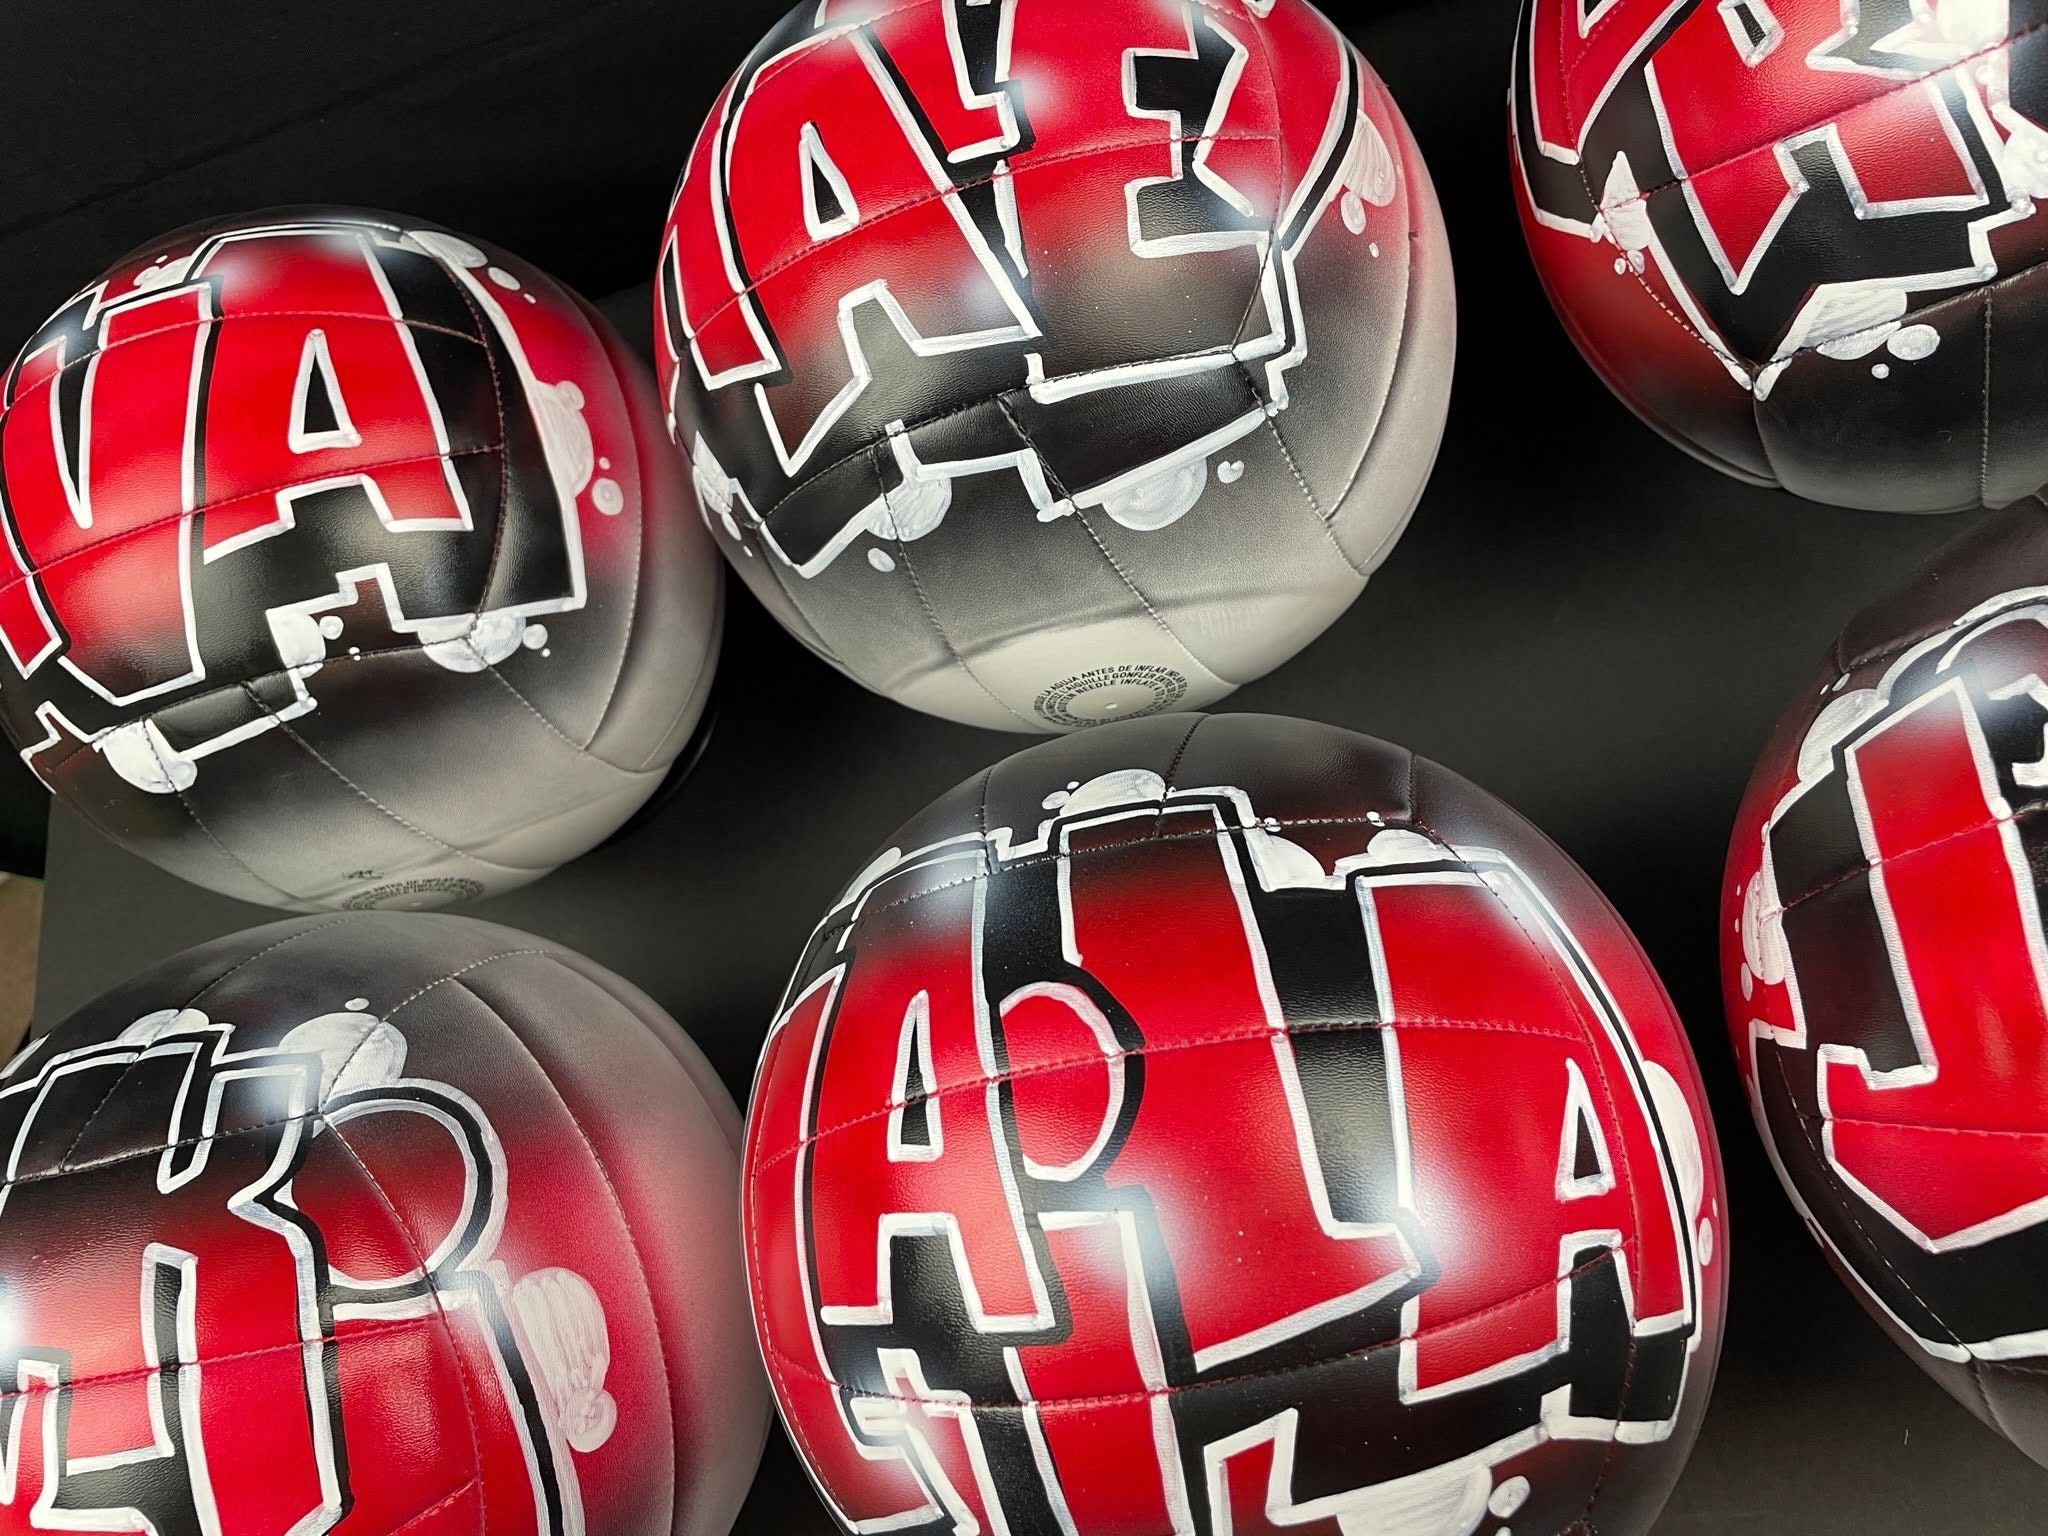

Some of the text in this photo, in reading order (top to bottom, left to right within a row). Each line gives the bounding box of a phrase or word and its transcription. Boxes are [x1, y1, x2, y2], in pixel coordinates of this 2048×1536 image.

[1050, 676, 1080, 690] AGUJA
[1081, 666, 1115, 679] ANTES
[1135, 665, 1167, 674] INFLAR
[1112, 672, 1156, 680] GONFLER
[1075, 680, 1116, 694] NEEDLE
[1121, 678, 1159, 688] INFLATE
